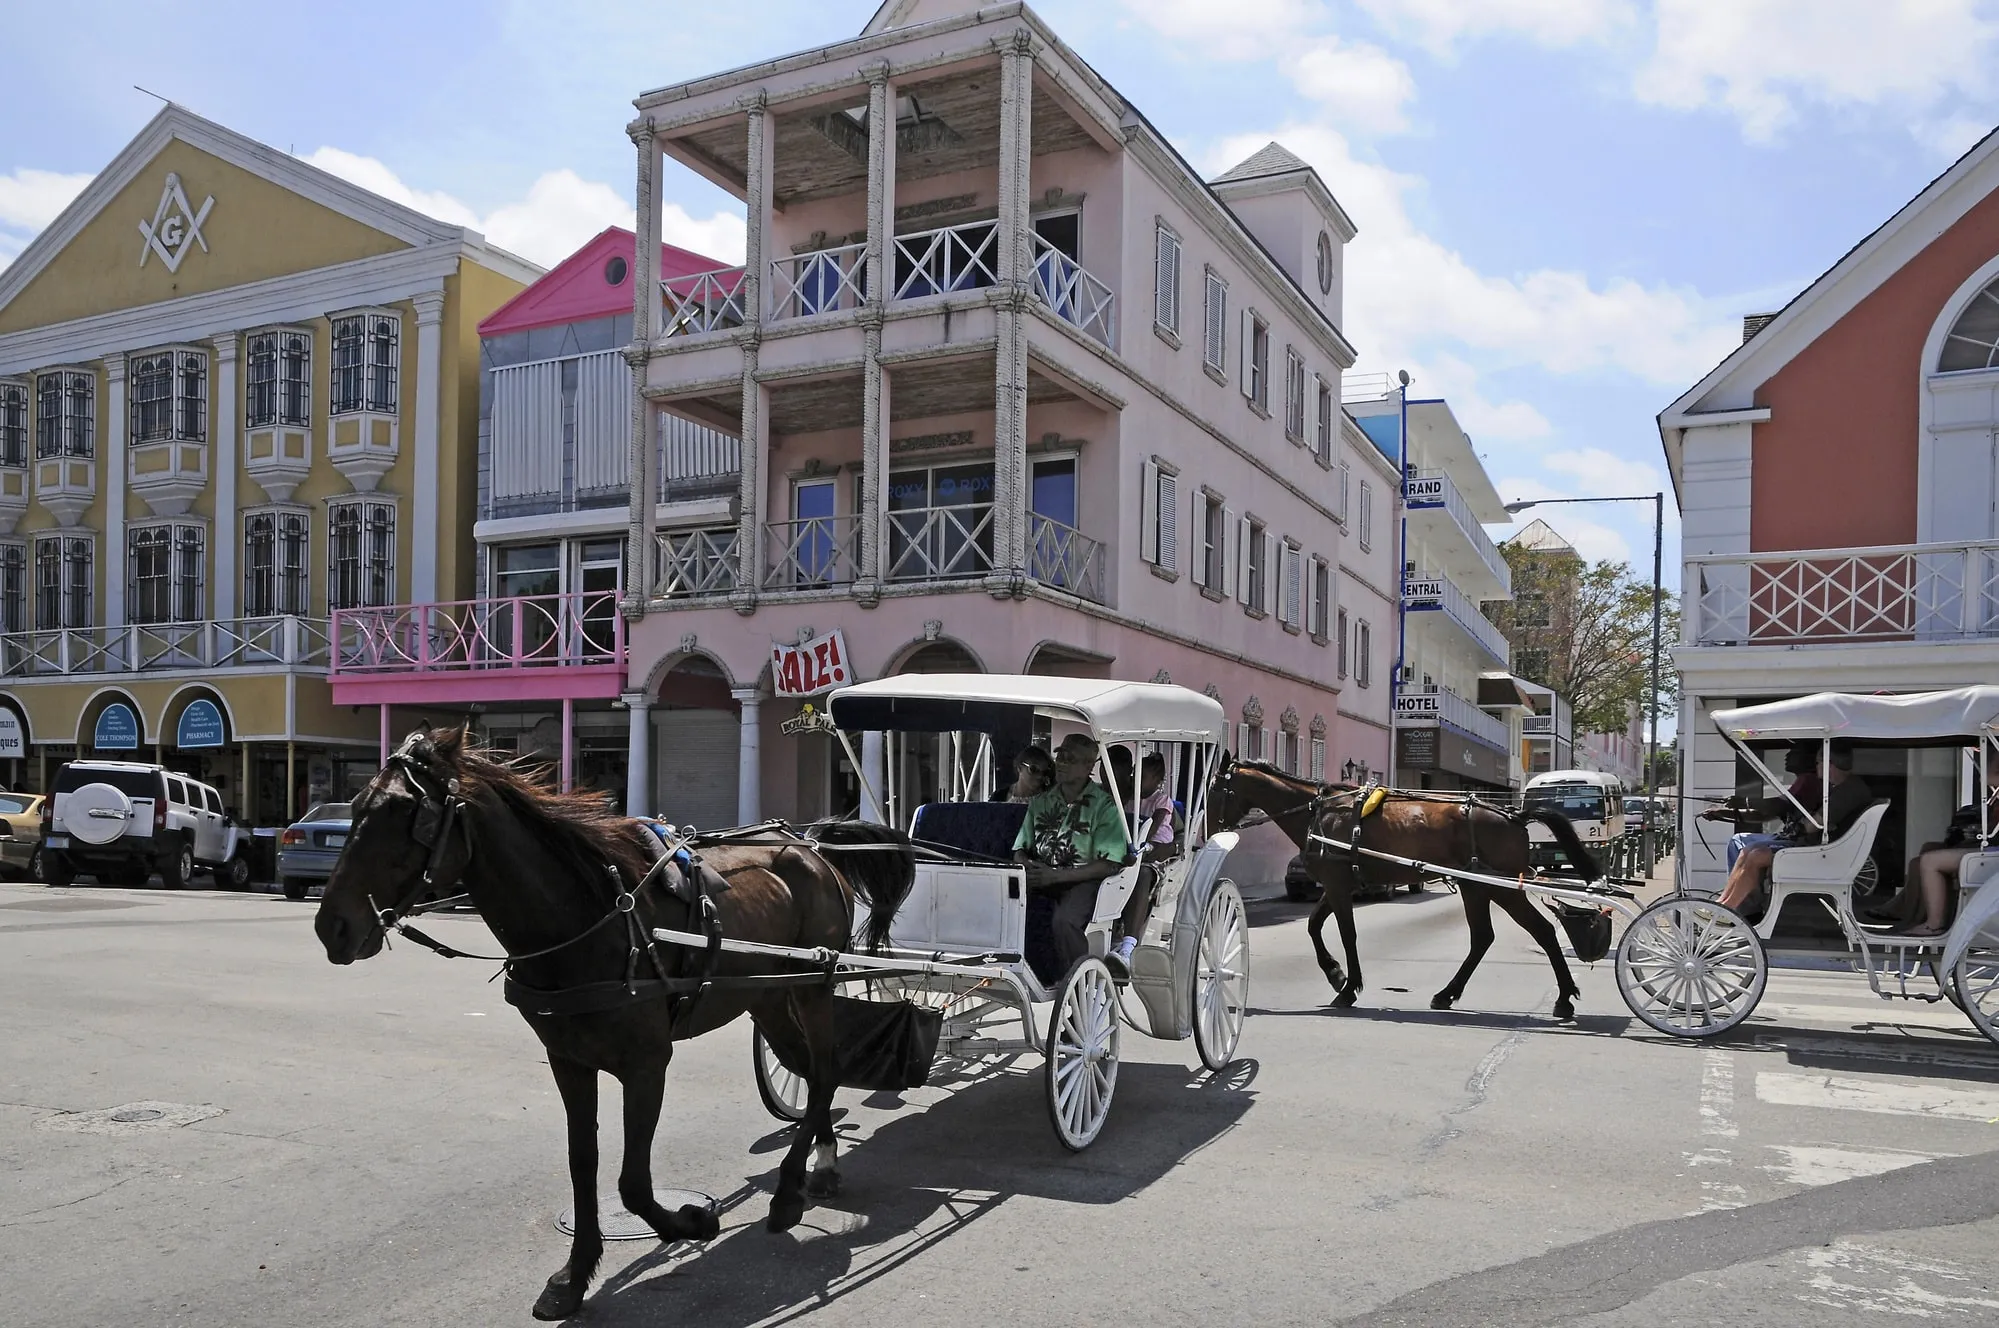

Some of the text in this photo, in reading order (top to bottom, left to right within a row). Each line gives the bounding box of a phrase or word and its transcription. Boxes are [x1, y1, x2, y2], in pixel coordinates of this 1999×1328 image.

[161, 215, 183, 247] G
[1401, 482, 1441, 495] RAND
[1402, 583, 1442, 596] ENTRAL
[1397, 698, 1438, 710] HOTEL
[783, 719, 811, 733] ROYAL
[186, 731, 214, 740] PHARMACY
[1589, 827, 1602, 837] 21
